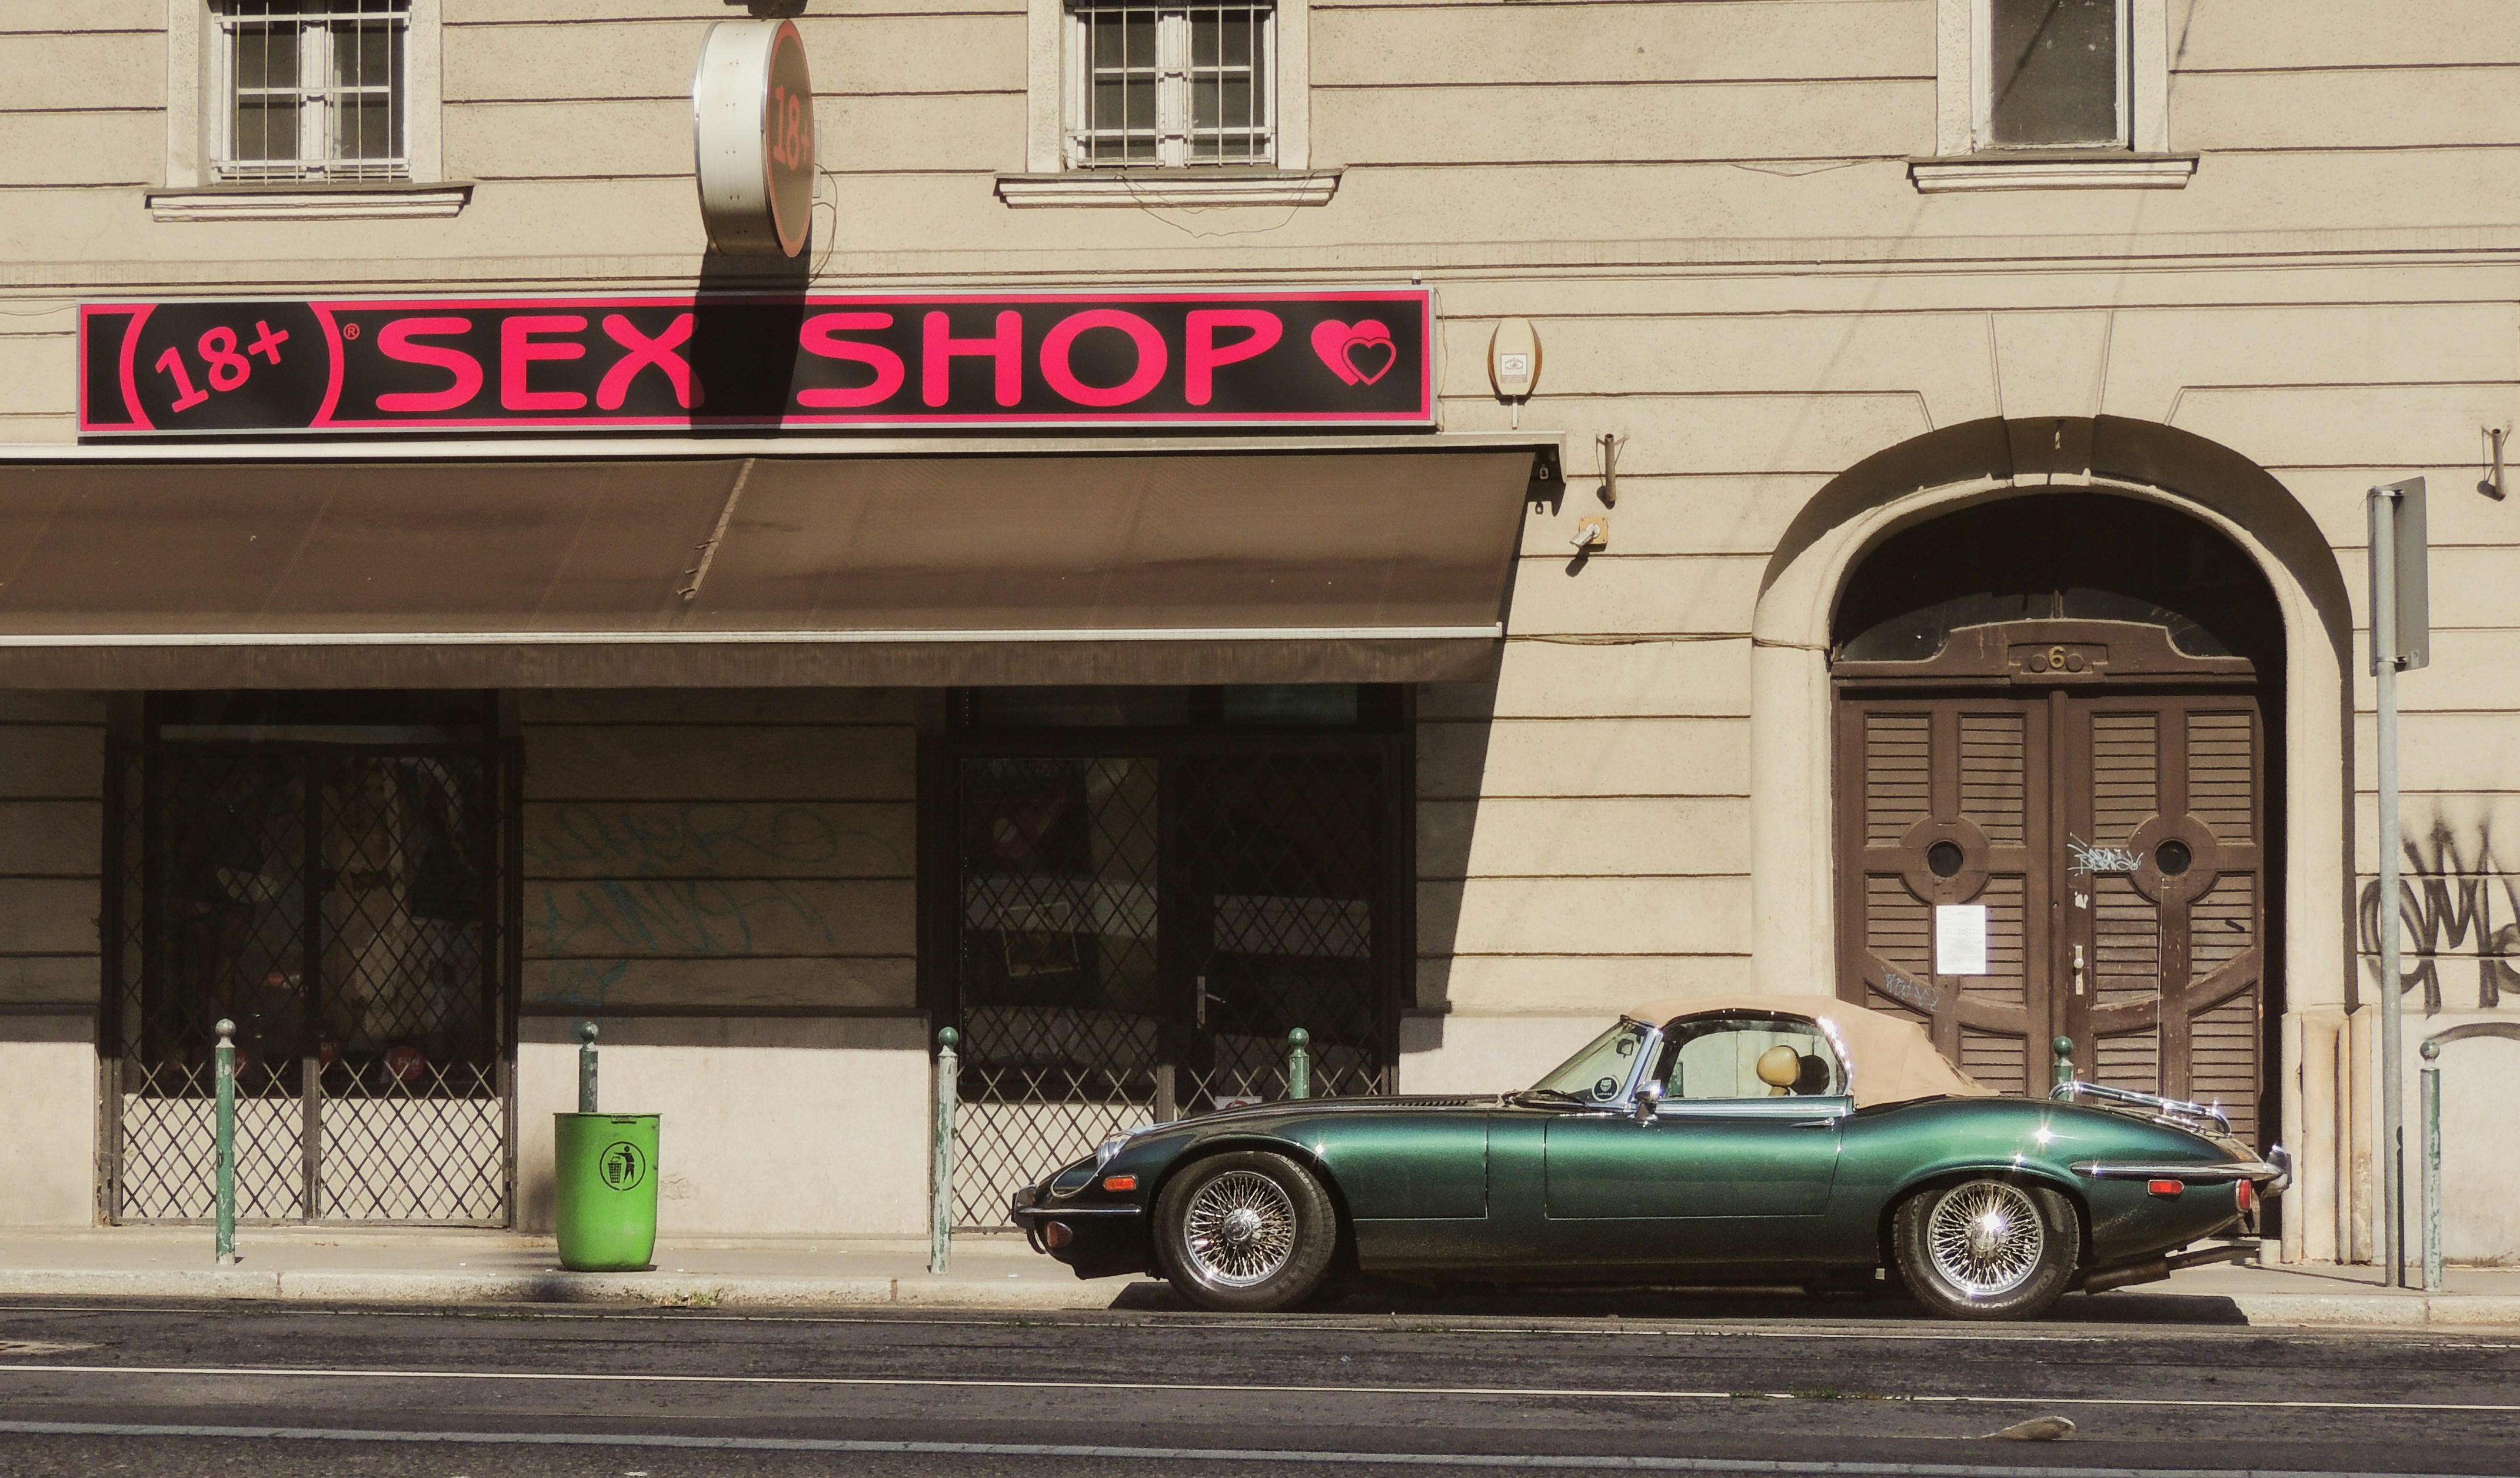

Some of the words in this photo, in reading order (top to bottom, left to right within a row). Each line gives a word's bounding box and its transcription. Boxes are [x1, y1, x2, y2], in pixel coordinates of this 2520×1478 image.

[773, 85, 810, 170] 18+
[155, 319, 290, 413] 18+
[375, 312, 705, 413] SEX
[796, 308, 1284, 408] SHOP
[2049, 646, 2065, 668] 6
